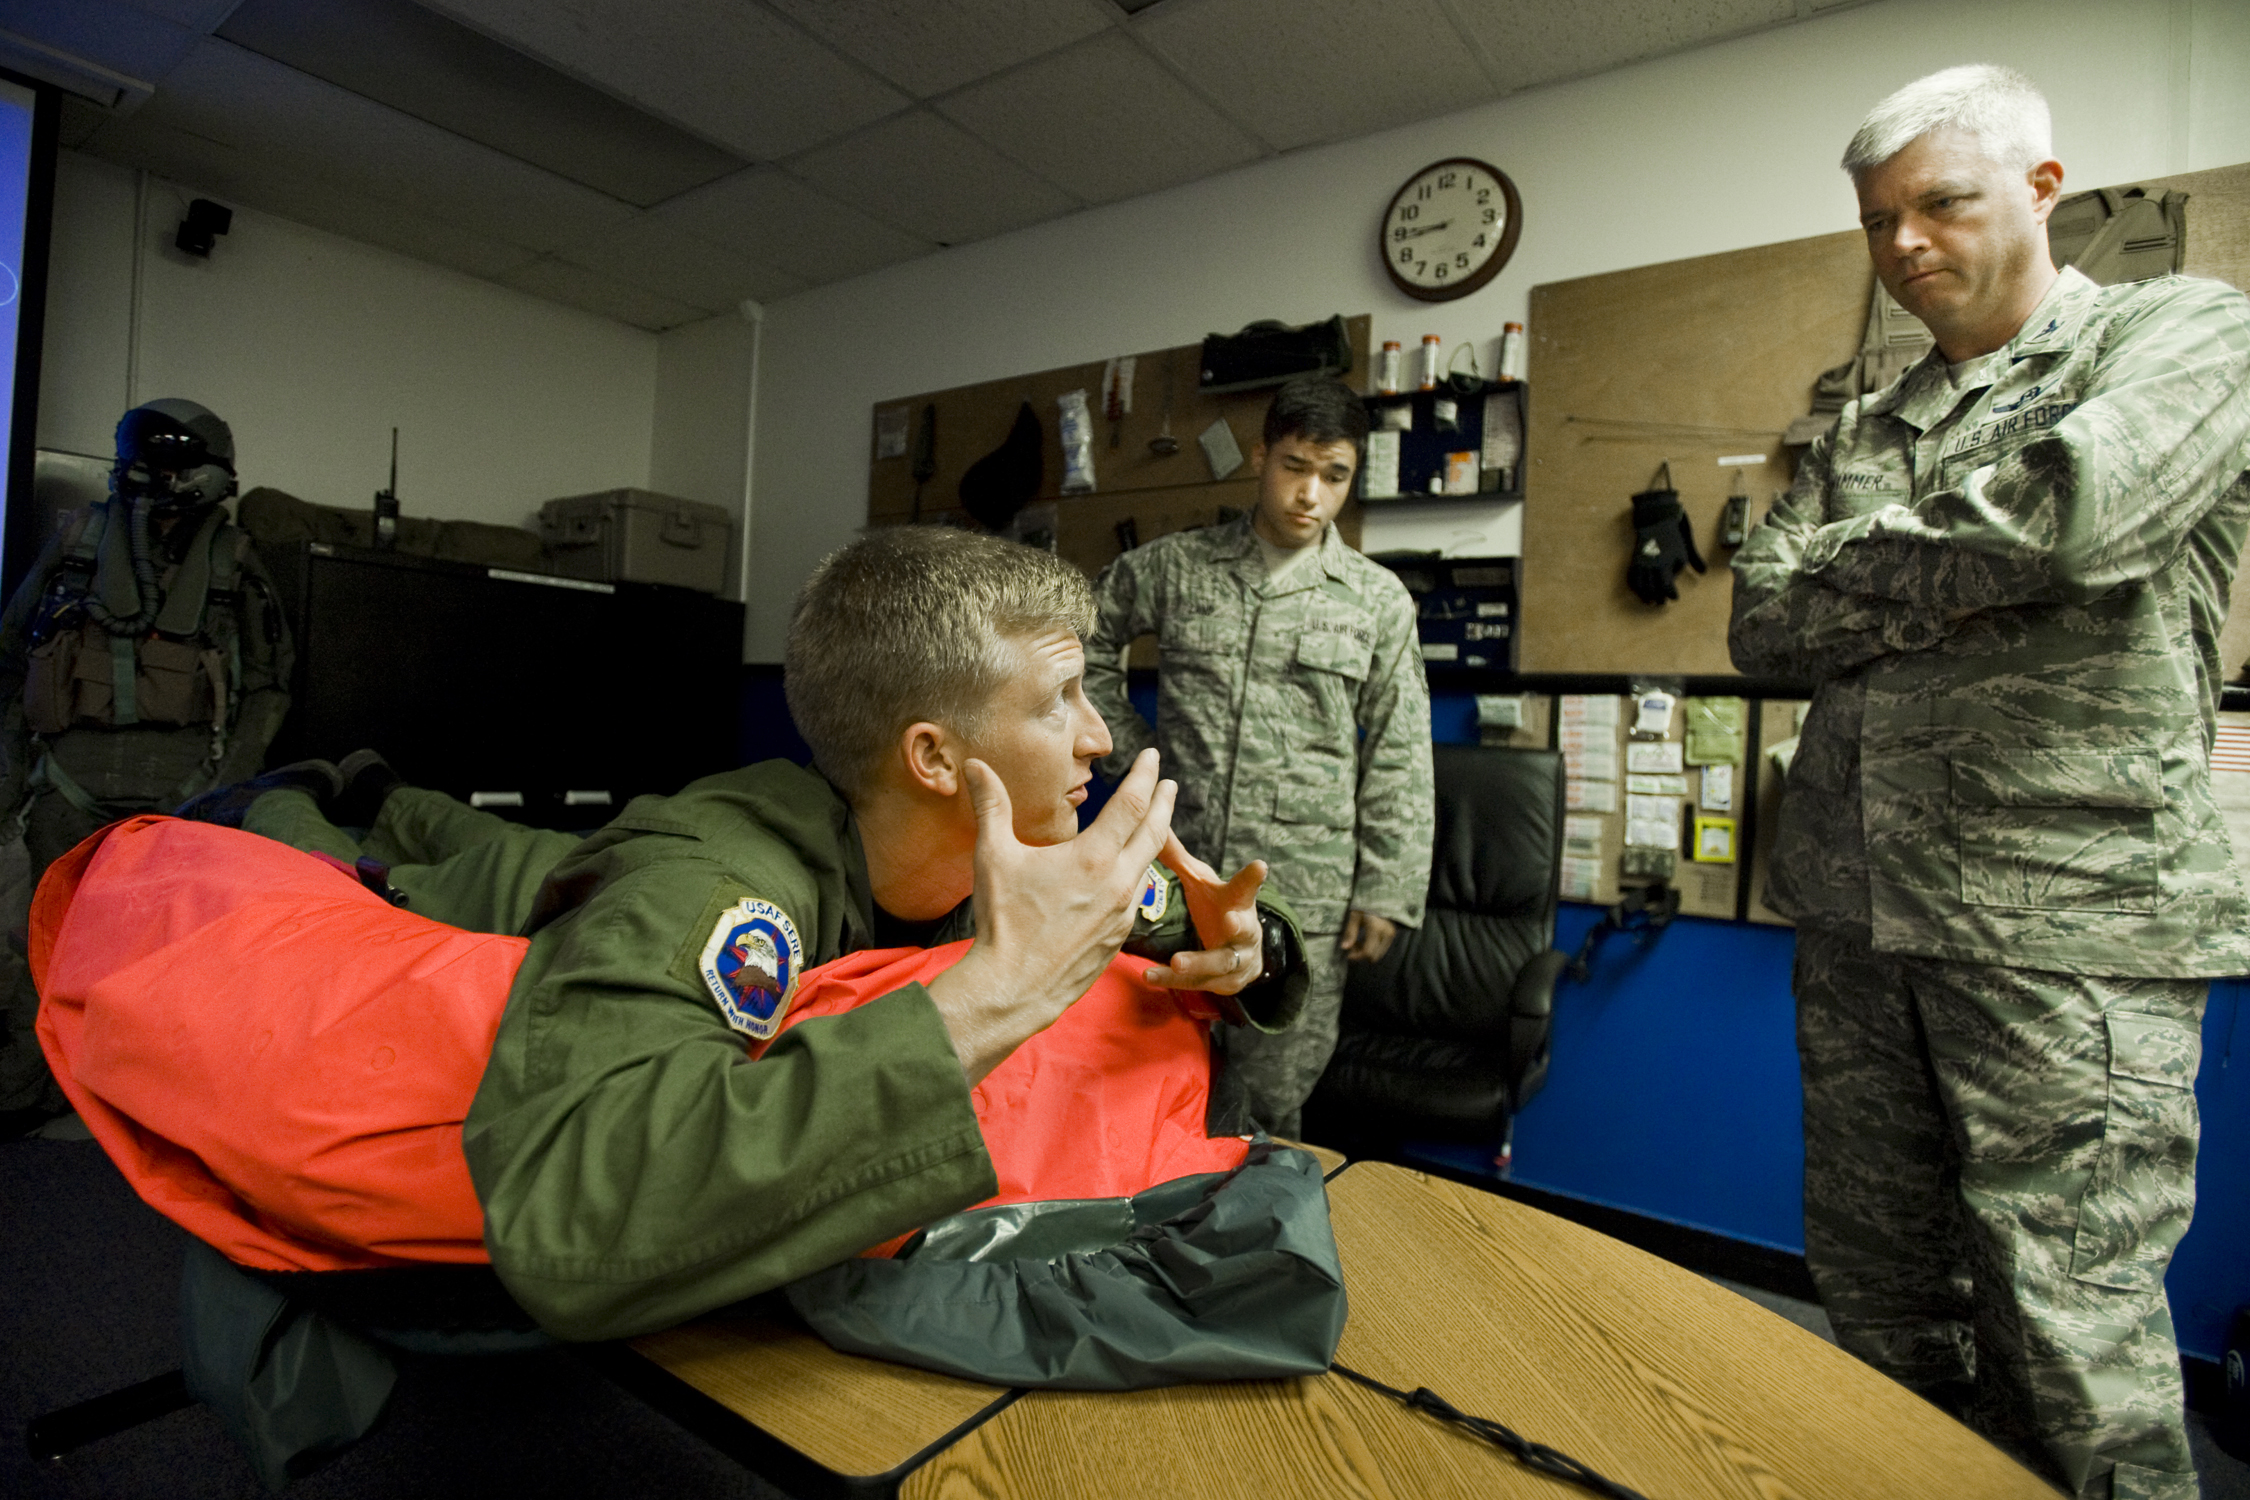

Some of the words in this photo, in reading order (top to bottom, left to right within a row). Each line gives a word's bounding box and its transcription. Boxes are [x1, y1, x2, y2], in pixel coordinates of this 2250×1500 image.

[1438, 173, 1456, 190] 12
[1466, 175, 1473, 190] 1
[1418, 185, 1431, 200] 11
[1477, 188, 1490, 205] 2
[1401, 204, 1419, 221] 10
[1482, 208, 1496, 224] 3
[1394, 226, 1407, 242] 9
[1472, 233, 1485, 248] 4
[1400, 247, 1413, 263] 8
[1455, 252, 1469, 268] 5
[1415, 260, 1427, 276] 7
[1435, 262, 1448, 278] 6
[1955, 430, 1985, 452] U.S.
[1991, 415, 2018, 441] AIR
[1333, 624, 1347, 636] AIR
[746, 902, 783, 920] USAF
[783, 920, 800, 959] SERE
[706, 969, 729, 1006] RETURN
[728, 1006, 744, 1026] WITH
[746, 1019, 768, 1036] HONOR
